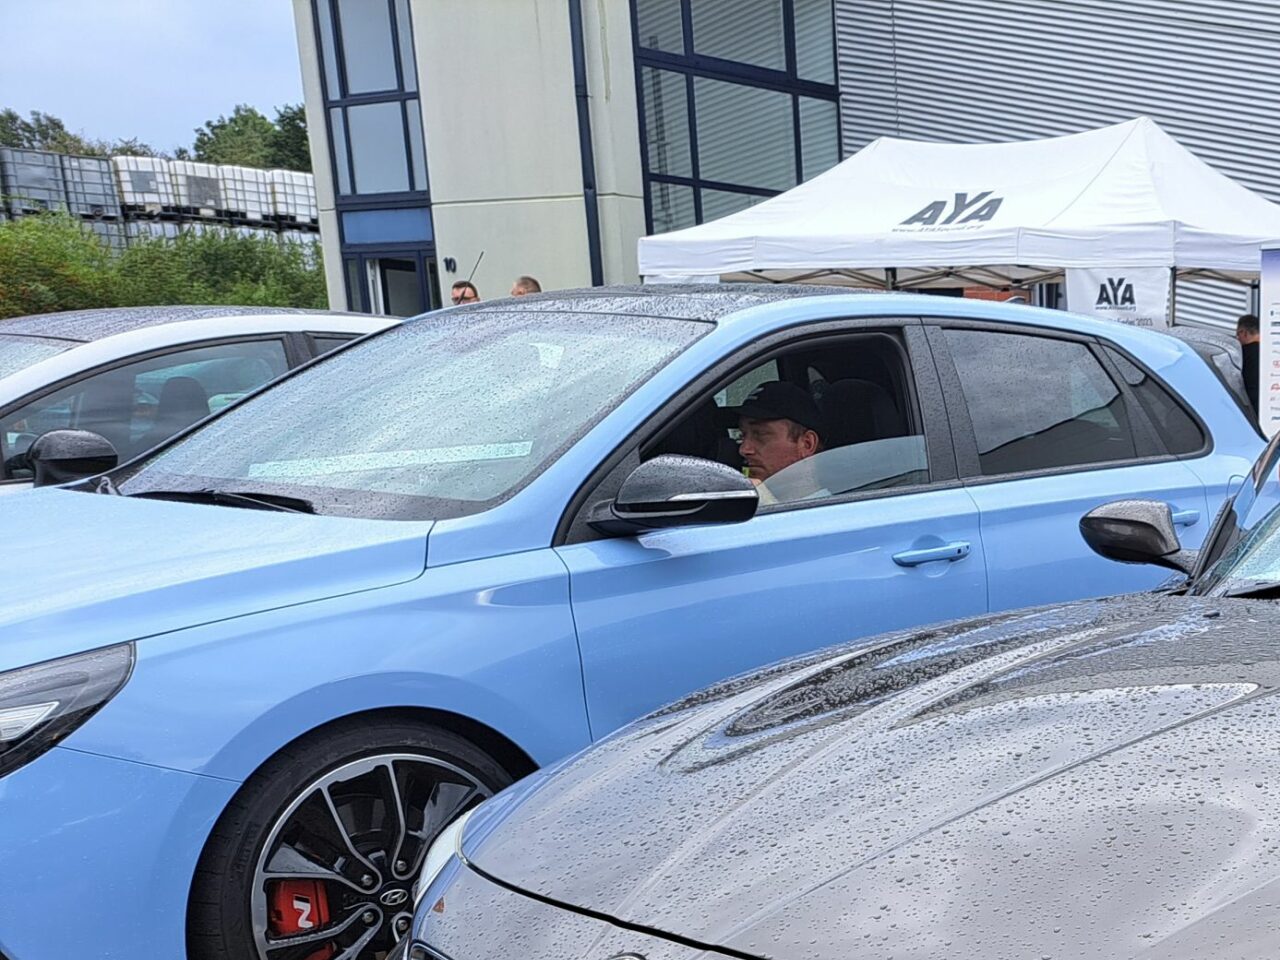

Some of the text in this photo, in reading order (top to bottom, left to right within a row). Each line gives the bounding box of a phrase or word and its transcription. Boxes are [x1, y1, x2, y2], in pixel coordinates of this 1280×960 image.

[899, 190, 1004, 225] AYA
[443, 257, 457, 273] 10
[1096, 278, 1136, 305] AYA
